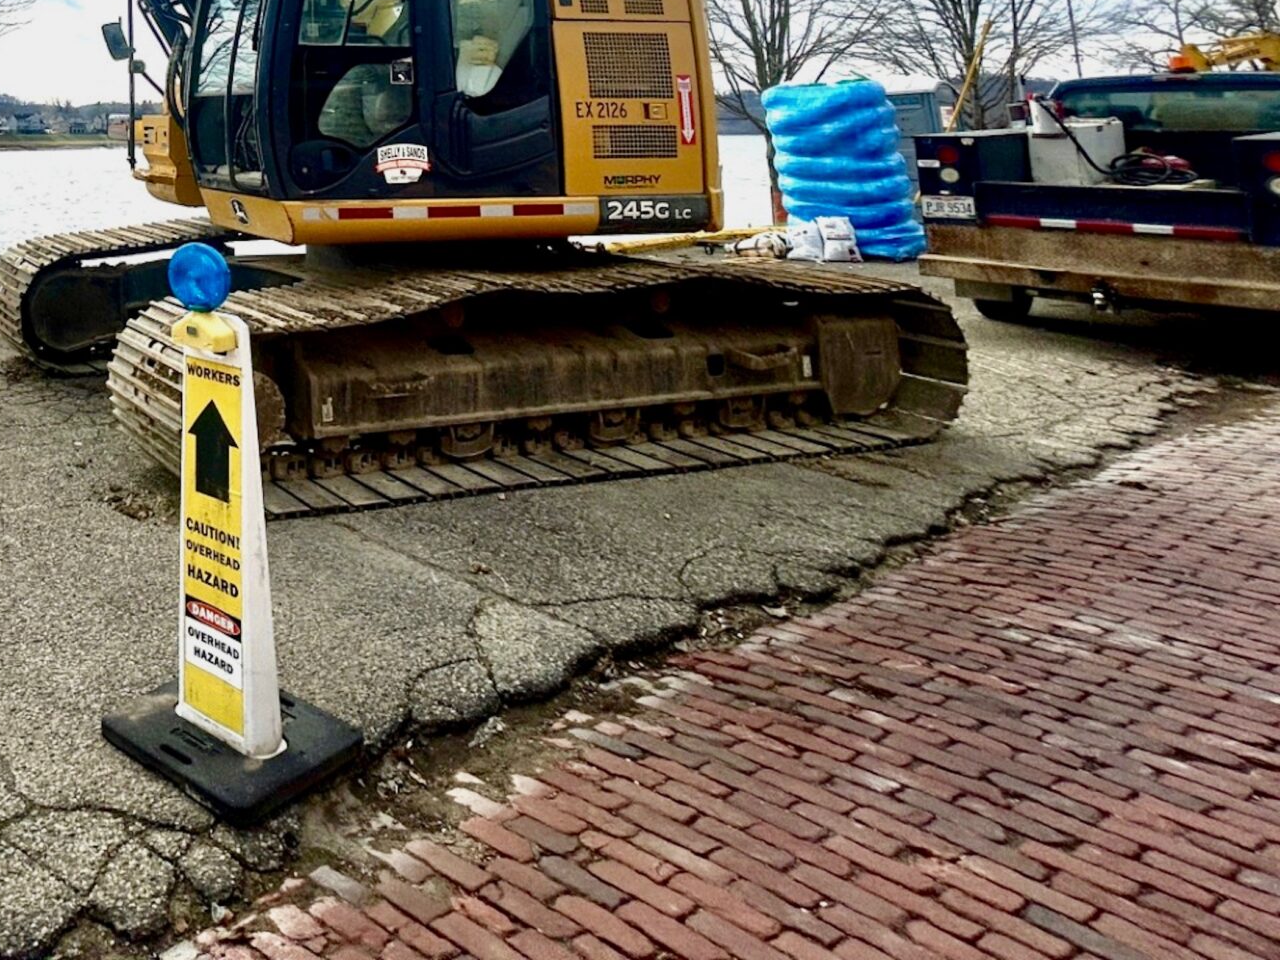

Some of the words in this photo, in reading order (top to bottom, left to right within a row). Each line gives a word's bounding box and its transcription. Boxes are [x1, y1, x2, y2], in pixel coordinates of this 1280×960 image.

[576, 102, 594, 119] EX
[597, 102, 628, 119] 2126
[380, 147, 400, 160] SHELLY
[407, 146, 426, 160] SANDS
[607, 200, 670, 220] 245G
[675, 208, 692, 219] LC
[187, 363, 241, 387] WORKERS
[186, 517, 241, 551] CAUTION!
[186, 539, 241, 572] OVERHEAD
[187, 564, 239, 599] HAZARD
[191, 603, 236, 632] DANGER
[188, 626, 240, 660] OVERHEAD
[193, 646, 234, 675] HAZARD
